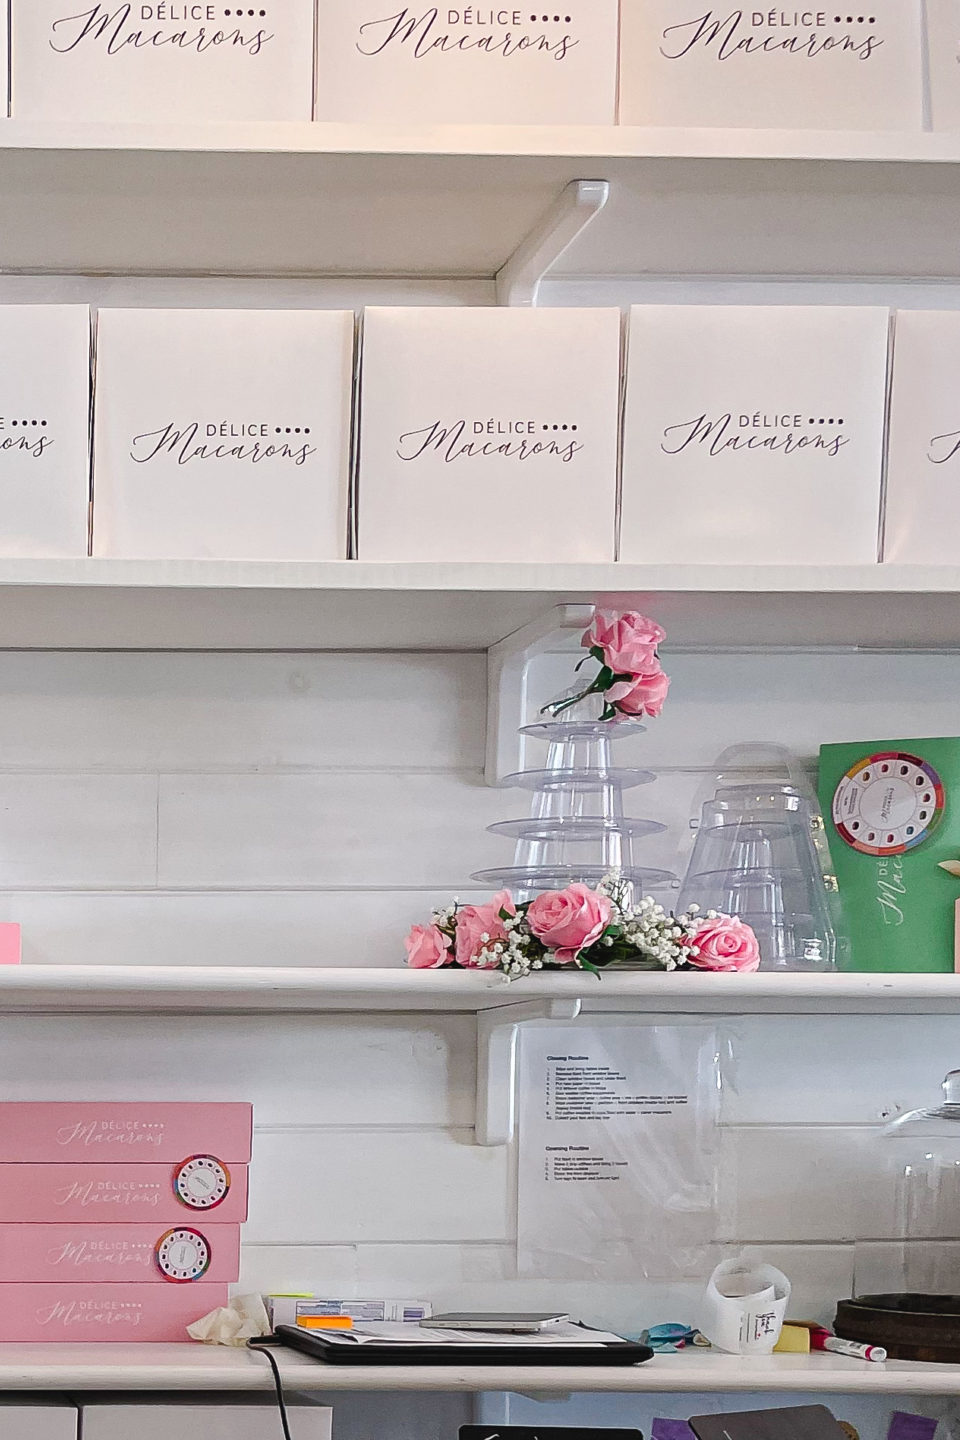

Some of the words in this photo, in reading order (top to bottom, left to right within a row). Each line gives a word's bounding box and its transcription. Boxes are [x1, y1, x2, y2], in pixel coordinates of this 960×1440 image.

[141, 2, 215, 20] DÉLICE
[448, 6, 521, 25] DÉLICE
[752, 8, 825, 26] DÉLICE
[49, 1, 274, 55] Macarons
[356, 6, 580, 60] Macarons
[660, 8, 884, 60] Macarons
[207, 421, 268, 436] DÉLICE
[474, 418, 535, 434] DÉLICE
[661, 412, 850, 456] Macarons
[739, 412, 801, 427] DÉLICE
[130, 421, 317, 465] Macarons
[397, 418, 584, 462] Macarons
